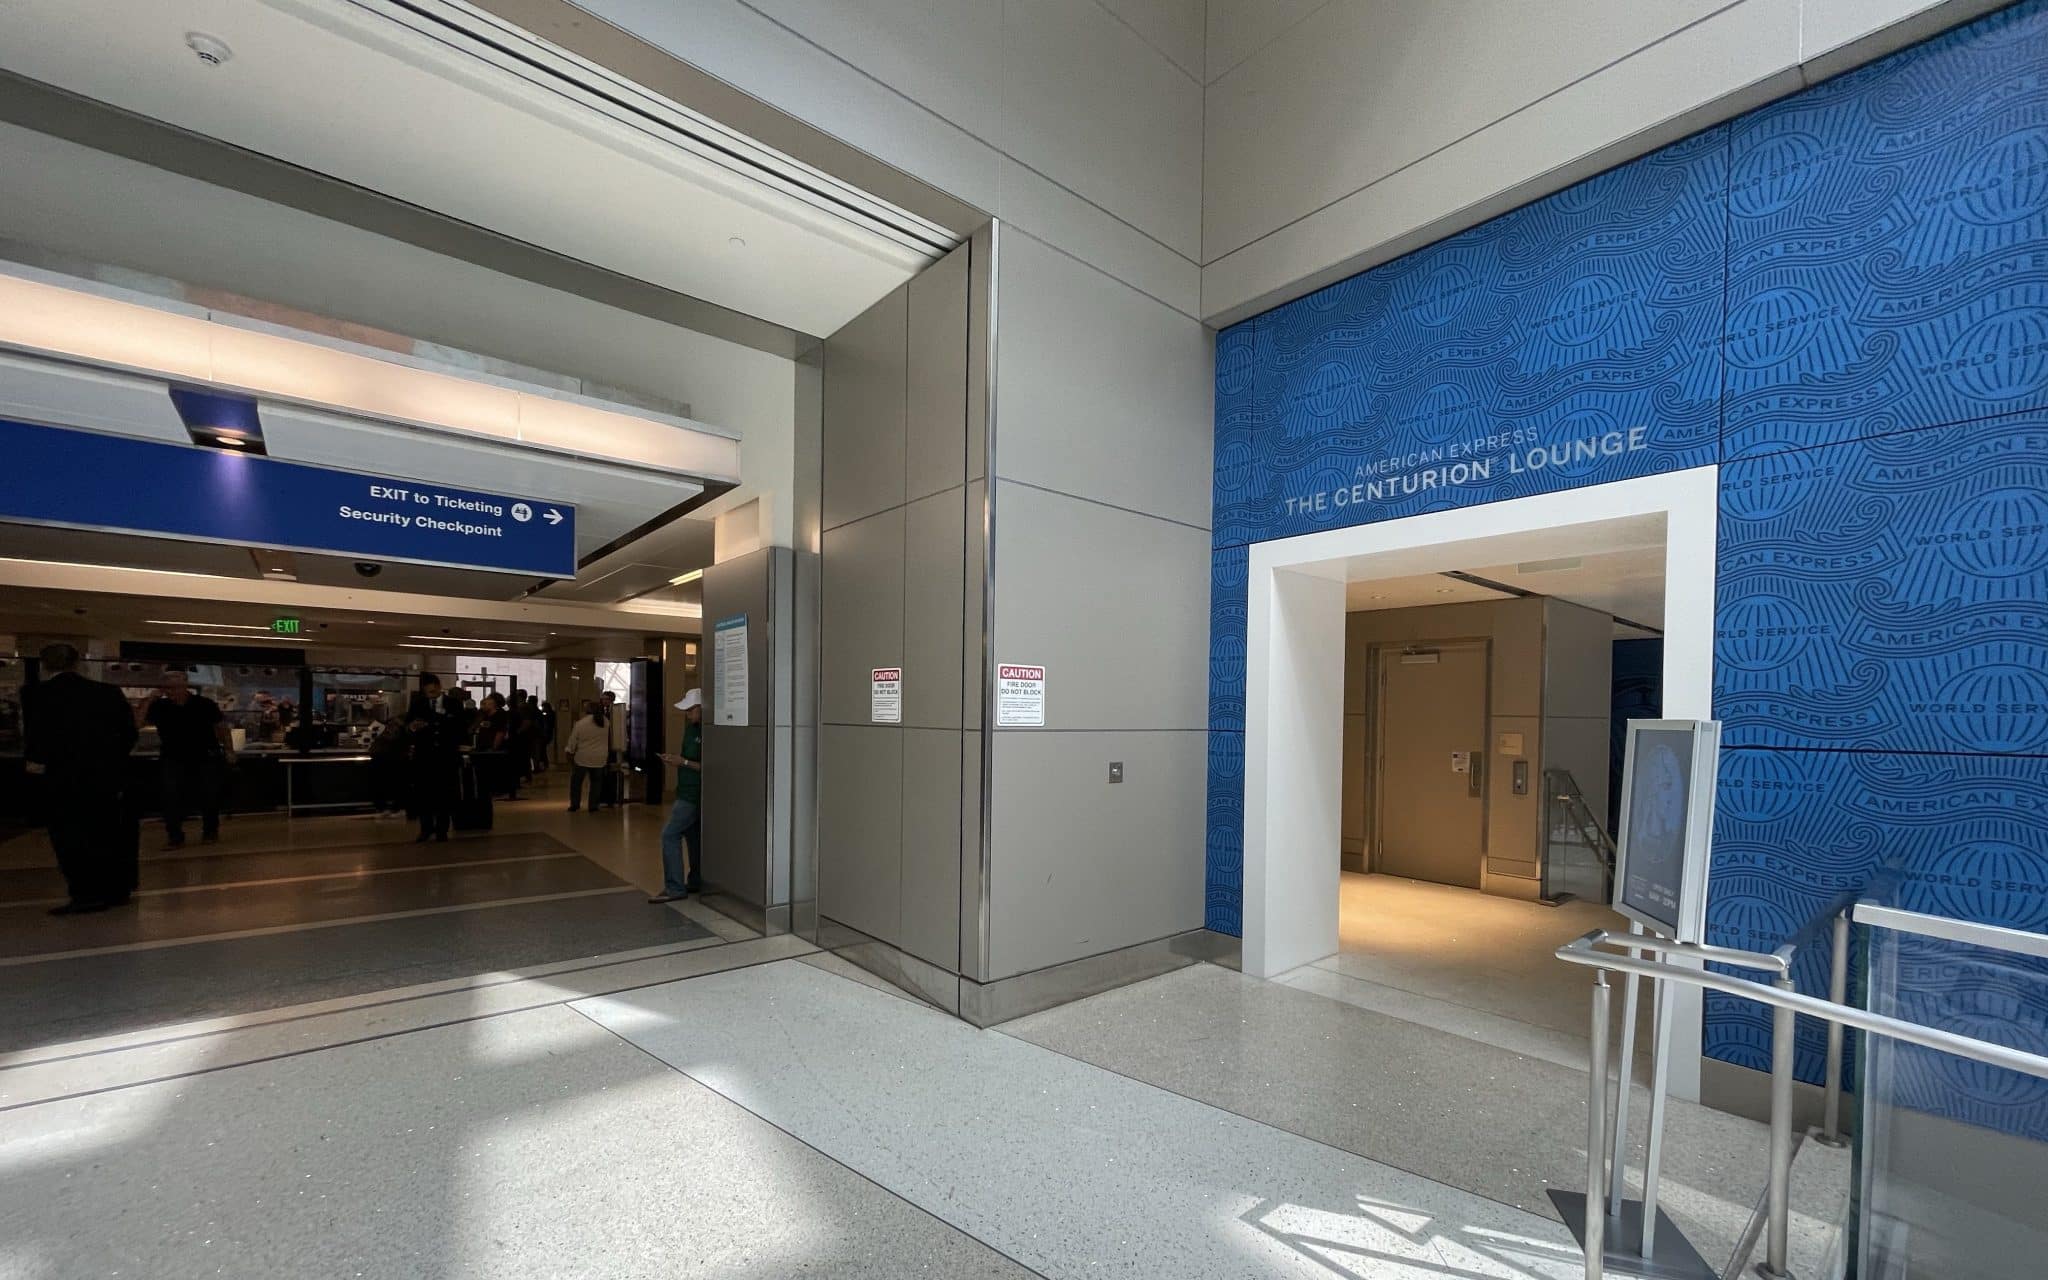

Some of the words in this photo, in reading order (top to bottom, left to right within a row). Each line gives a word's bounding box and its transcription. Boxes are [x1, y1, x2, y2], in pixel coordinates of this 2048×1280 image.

[1508, 240, 1589, 284] AMERICAN
[1595, 219, 1672, 246] EXPRESS
[1669, 249, 1774, 296] AMERICAN
[1783, 225, 1882, 254] EXPRESS
[1881, 259, 2018, 314] AMERICAN
[1530, 310, 1577, 330] WORLD
[1580, 290, 1639, 314] SERVICE
[1701, 328, 1758, 350] WORLD
[1765, 305, 1841, 332] SERVICE
[1448, 340, 1507, 358] EXPRESS
[1920, 353, 1997, 376] WORLD
[1505, 373, 1585, 409] AMERICAN
[1591, 360, 1668, 381] EXPRESS
[1438, 400, 1482, 417] SERVICE
[1663, 400, 1770, 440] AMERICAN
[1779, 386, 1880, 409] EXPRESS
[1354, 447, 1442, 479] AMERICAN
[1450, 426, 1539, 459] EXPRESS
[1875, 439, 2012, 481] AMERICAN
[1285, 492, 1328, 516] THE
[1334, 459, 1491, 507] CENTURION
[1510, 425, 1649, 474] LOUNGE
[1760, 467, 1835, 487] SERVICE
[370, 485, 409, 502] EXIT
[413, 492, 430, 505] to
[434, 495, 503, 517] Ticketing
[339, 506, 411, 527] Security
[415, 516, 503, 537] Checkpoint
[1915, 529, 1992, 546] WORLD
[1773, 552, 1873, 570] EXPRESS
[276, 619, 300, 634] EXIT
[1755, 625, 1832, 638] SERVICE
[1871, 616, 2007, 646] AMERICAN
[874, 671, 899, 681] CAUTION
[1002, 668, 1041, 679] CAUTION
[1769, 704, 1869, 728] EXPRESS
[1909, 703, 1986, 713] WORLD
[1751, 780, 1825, 793] SERVICE
[1864, 792, 2001, 814] AMERICAN
[1765, 857, 1864, 888] EXPRESS
[1905, 871, 1980, 888] WORLD
